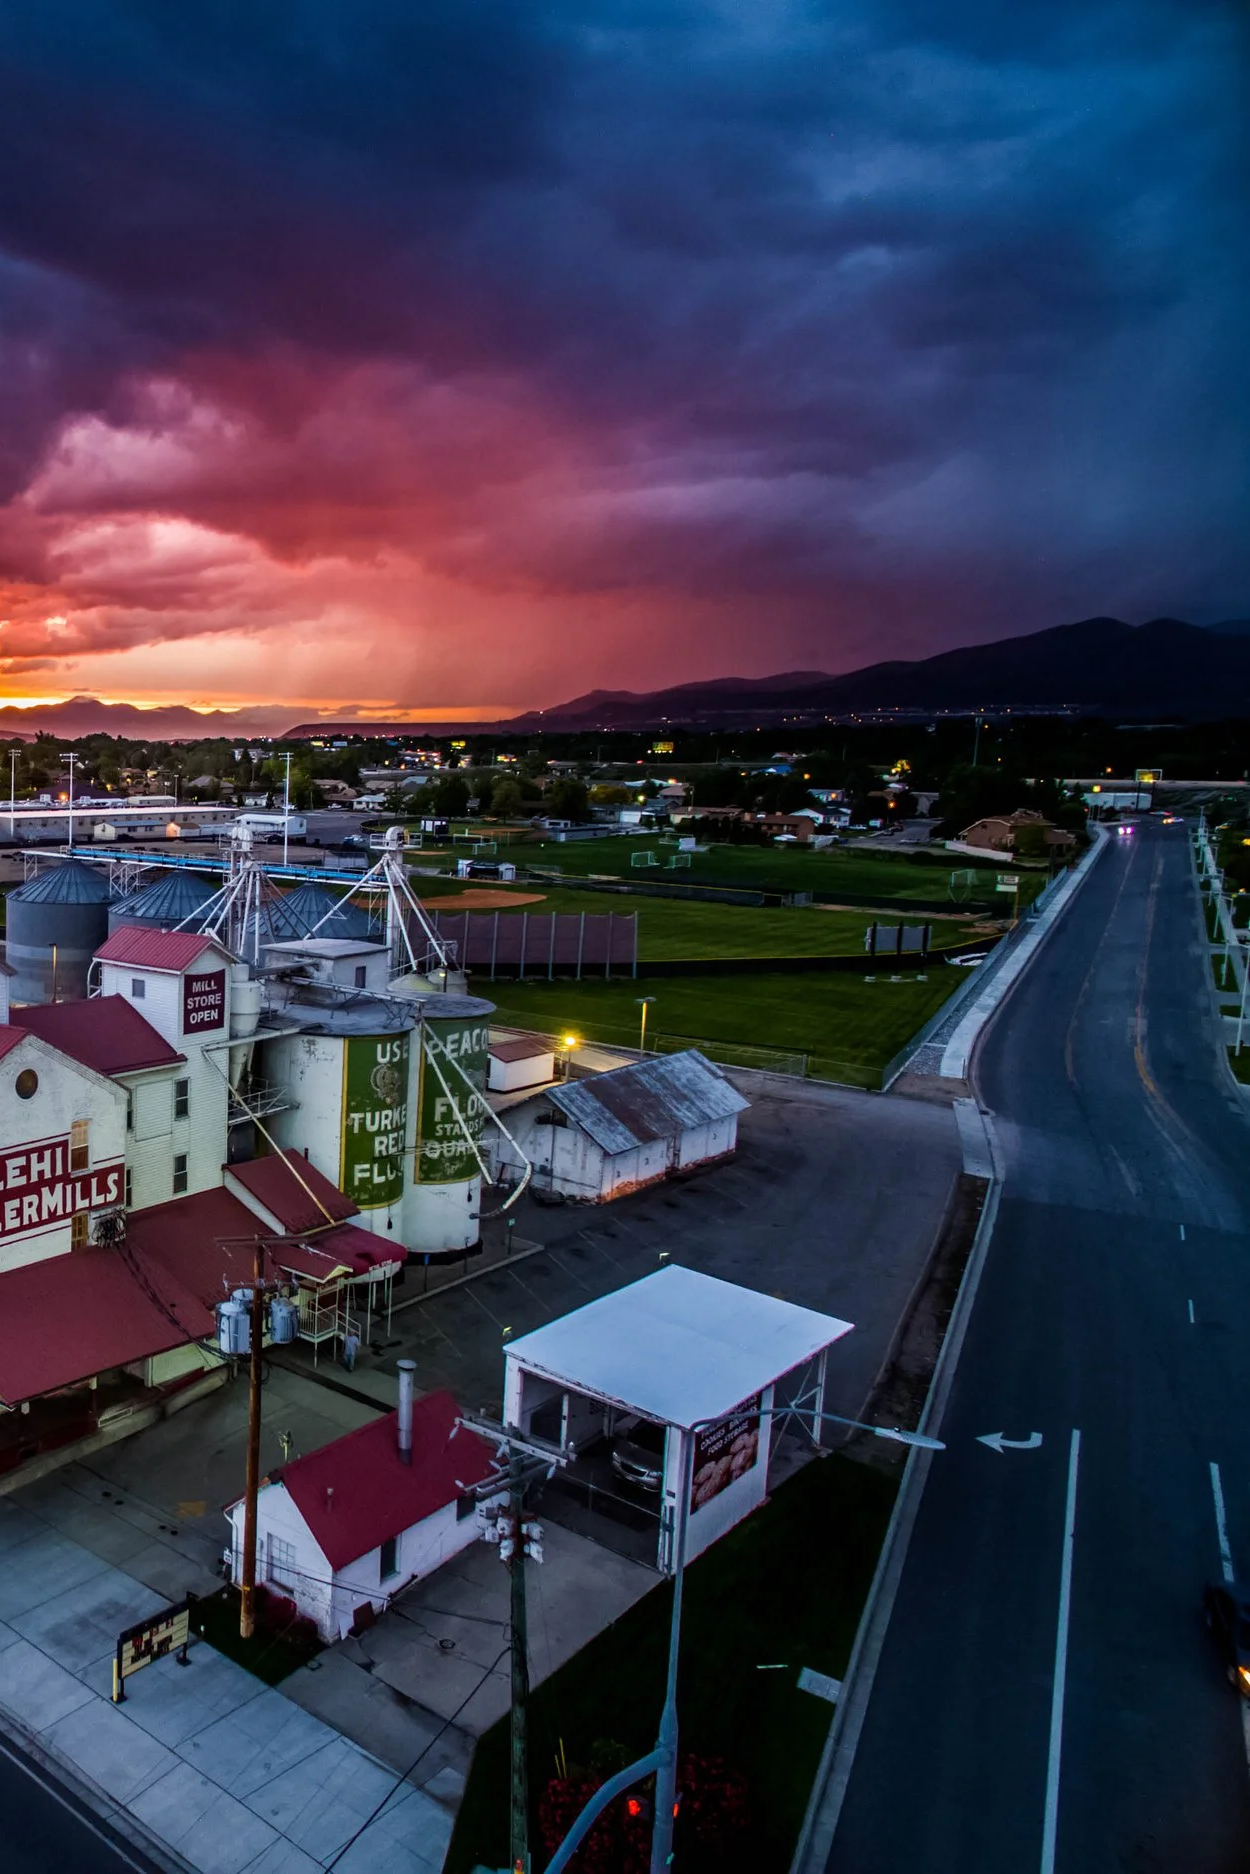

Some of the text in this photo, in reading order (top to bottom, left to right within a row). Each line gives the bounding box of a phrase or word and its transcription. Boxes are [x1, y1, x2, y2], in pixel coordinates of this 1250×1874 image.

[192, 980, 217, 993] MILL
[187, 993, 221, 1009] STORE
[190, 1009, 218, 1024] OPEN
[376, 1039, 408, 1064] USE
